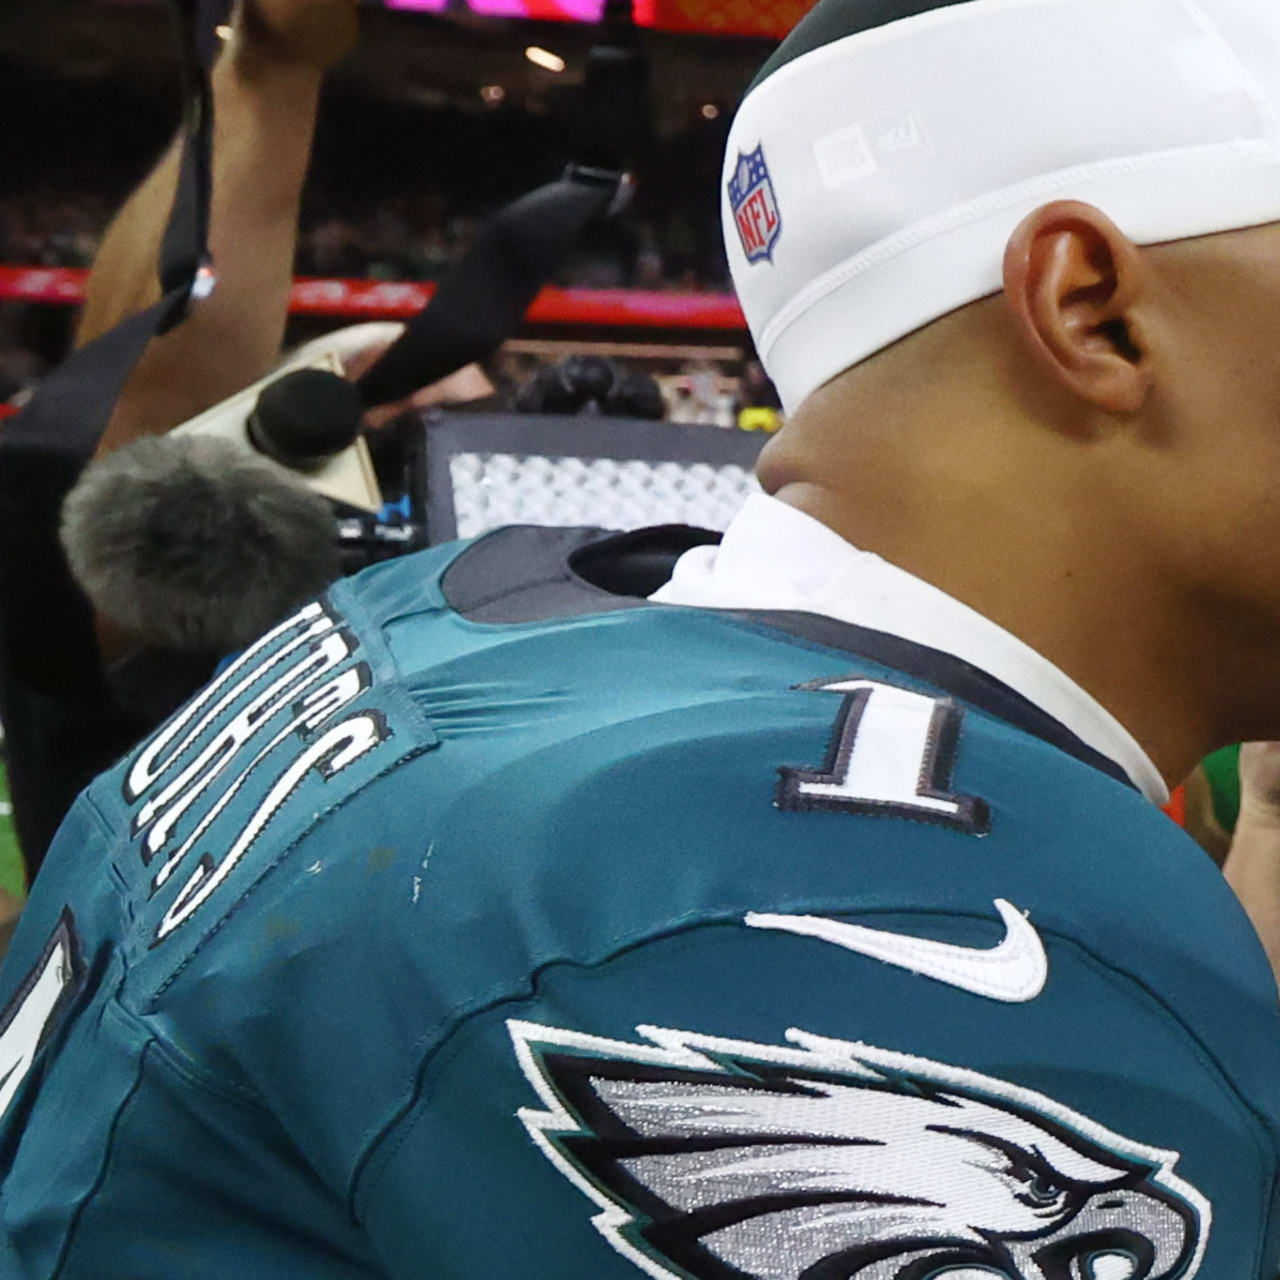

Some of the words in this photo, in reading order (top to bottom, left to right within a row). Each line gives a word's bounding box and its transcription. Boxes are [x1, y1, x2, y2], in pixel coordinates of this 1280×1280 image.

[735, 186, 778, 256] NFL
[121, 596, 396, 952] URTS
[774, 676, 993, 837] 1
